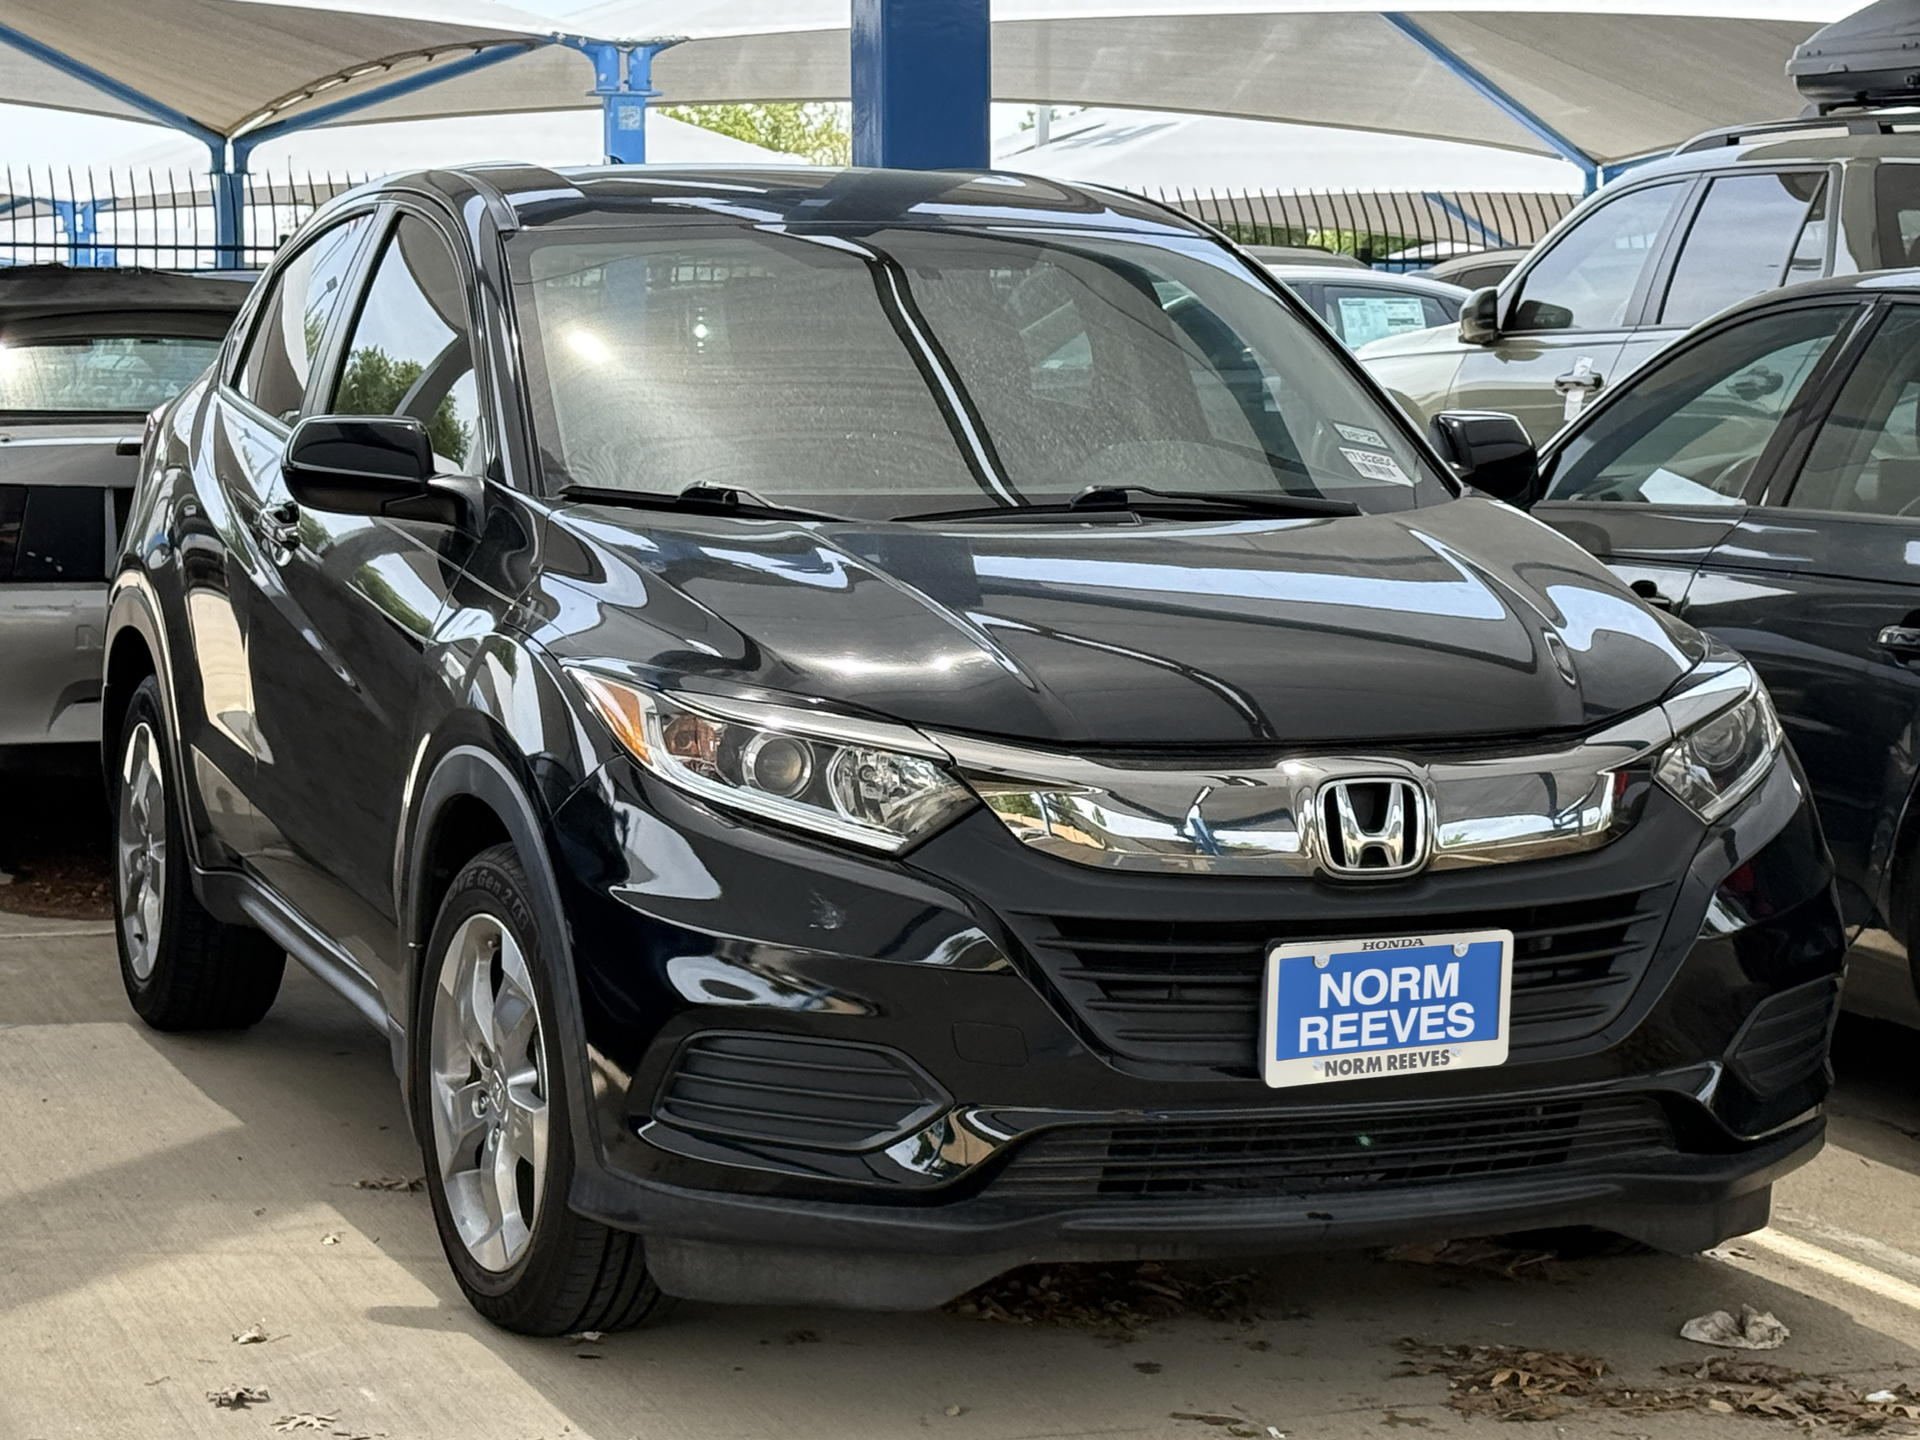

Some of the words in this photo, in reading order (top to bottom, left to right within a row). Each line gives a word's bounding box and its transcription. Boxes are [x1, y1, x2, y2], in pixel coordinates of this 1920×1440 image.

[477, 869, 502, 896] Gen
[500, 888, 513, 905] 2
[1361, 938, 1425, 951] HONDA
[1319, 962, 1460, 1009] NORM
[1299, 1002, 1475, 1053] REEVES
[1324, 1056, 1383, 1078] NORM
[1387, 1049, 1450, 1071] REEVES
